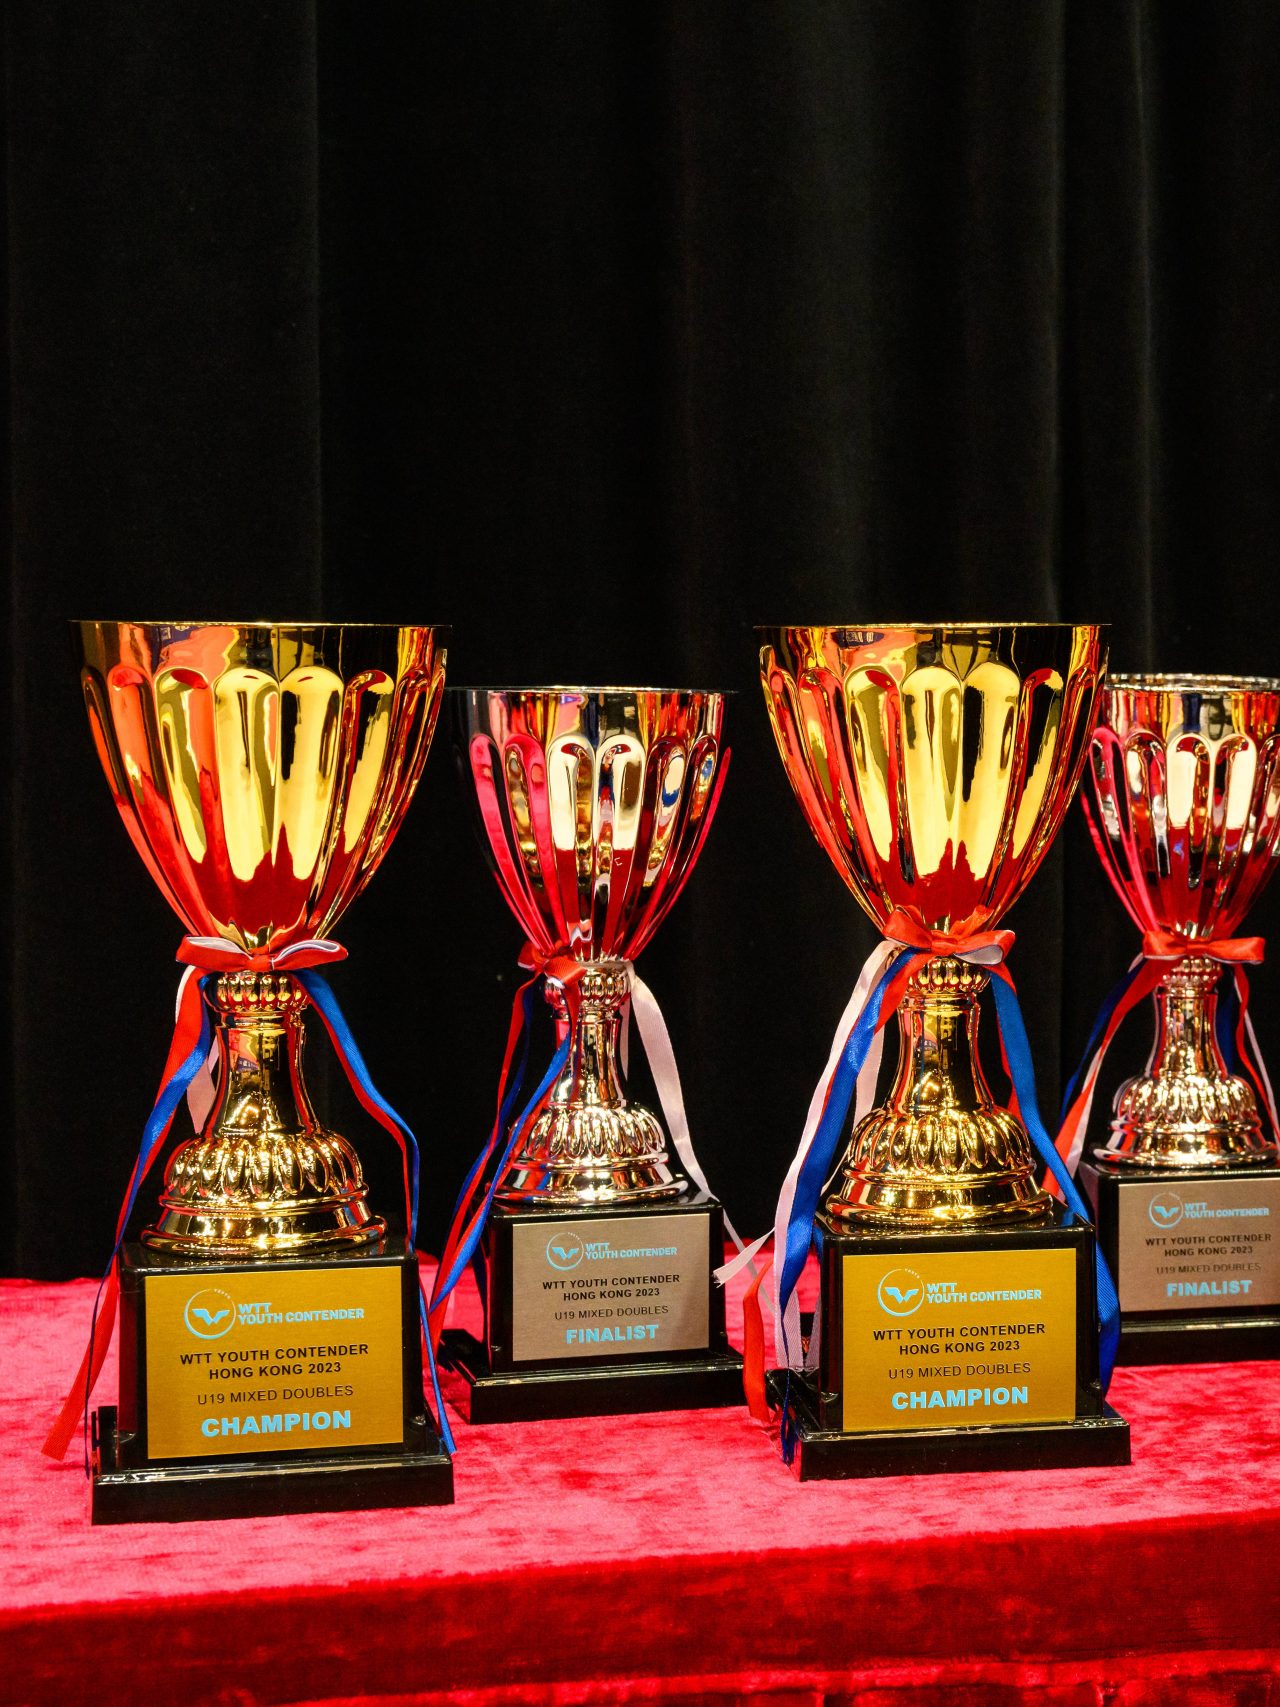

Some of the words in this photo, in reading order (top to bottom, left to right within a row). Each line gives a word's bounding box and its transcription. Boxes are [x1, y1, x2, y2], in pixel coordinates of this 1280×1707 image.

[1185, 1202, 1207, 1210] WTT
[1185, 1210, 1214, 1218] YOUTH
[1217, 1208, 1269, 1217] CONTENDER
[586, 1243, 609, 1251] WTT
[1145, 1238, 1167, 1246] WTT
[1171, 1236, 1205, 1245] YOUTH
[1209, 1234, 1271, 1243] CONTENDER
[586, 1250, 617, 1260] YOUTH
[620, 1248, 677, 1258] CONTENDER
[1164, 1248, 1194, 1257] HONG
[1198, 1247, 1227, 1255] KONG
[1231, 1246, 1253, 1254] 2023
[1157, 1266, 1175, 1274] U19
[1179, 1265, 1210, 1273] MIXED
[1214, 1262, 1261, 1271] DOUBLES
[543, 1281, 566, 1289] WTT
[570, 1279, 607, 1288] YOUTH
[612, 1275, 680, 1286] CONTENDER
[927, 1283, 957, 1293] WTT
[1167, 1280, 1252, 1297] FINALIST
[563, 1291, 596, 1301] HONG
[600, 1290, 632, 1299] KONG
[636, 1288, 660, 1297] 2023
[927, 1292, 967, 1304] YOUTH
[970, 1289, 1041, 1302] CONTENDER
[238, 1303, 271, 1313] WTT
[555, 1311, 574, 1320] U19
[579, 1309, 613, 1319] MIXED
[617, 1306, 668, 1317] DOUBLES
[238, 1313, 282, 1325] YOUTH
[285, 1309, 364, 1323] CONTENDER
[566, 1325, 659, 1344] FINALIST
[873, 1330, 902, 1341] WTT
[908, 1328, 954, 1339] YOUTH
[960, 1324, 1045, 1337] CONTENDER
[180, 1353, 211, 1365] WTT
[218, 1350, 269, 1362] YOUTH
[275, 1344, 368, 1360] CONTENDER
[899, 1344, 940, 1355] HONG
[945, 1342, 985, 1353] KONG
[990, 1341, 1020, 1351] 2023
[209, 1367, 253, 1379] HONG
[259, 1364, 303, 1377] KONG
[308, 1362, 341, 1373] 2023
[889, 1368, 913, 1379] U19
[919, 1366, 961, 1378] MIXED
[966, 1363, 1031, 1375] DOUBLES
[198, 1393, 225, 1405] U19
[231, 1389, 277, 1402] MIXED
[283, 1386, 353, 1399] DOUBLES
[892, 1387, 1028, 1410] CHAMPION
[202, 1410, 351, 1437] CHAMPION
